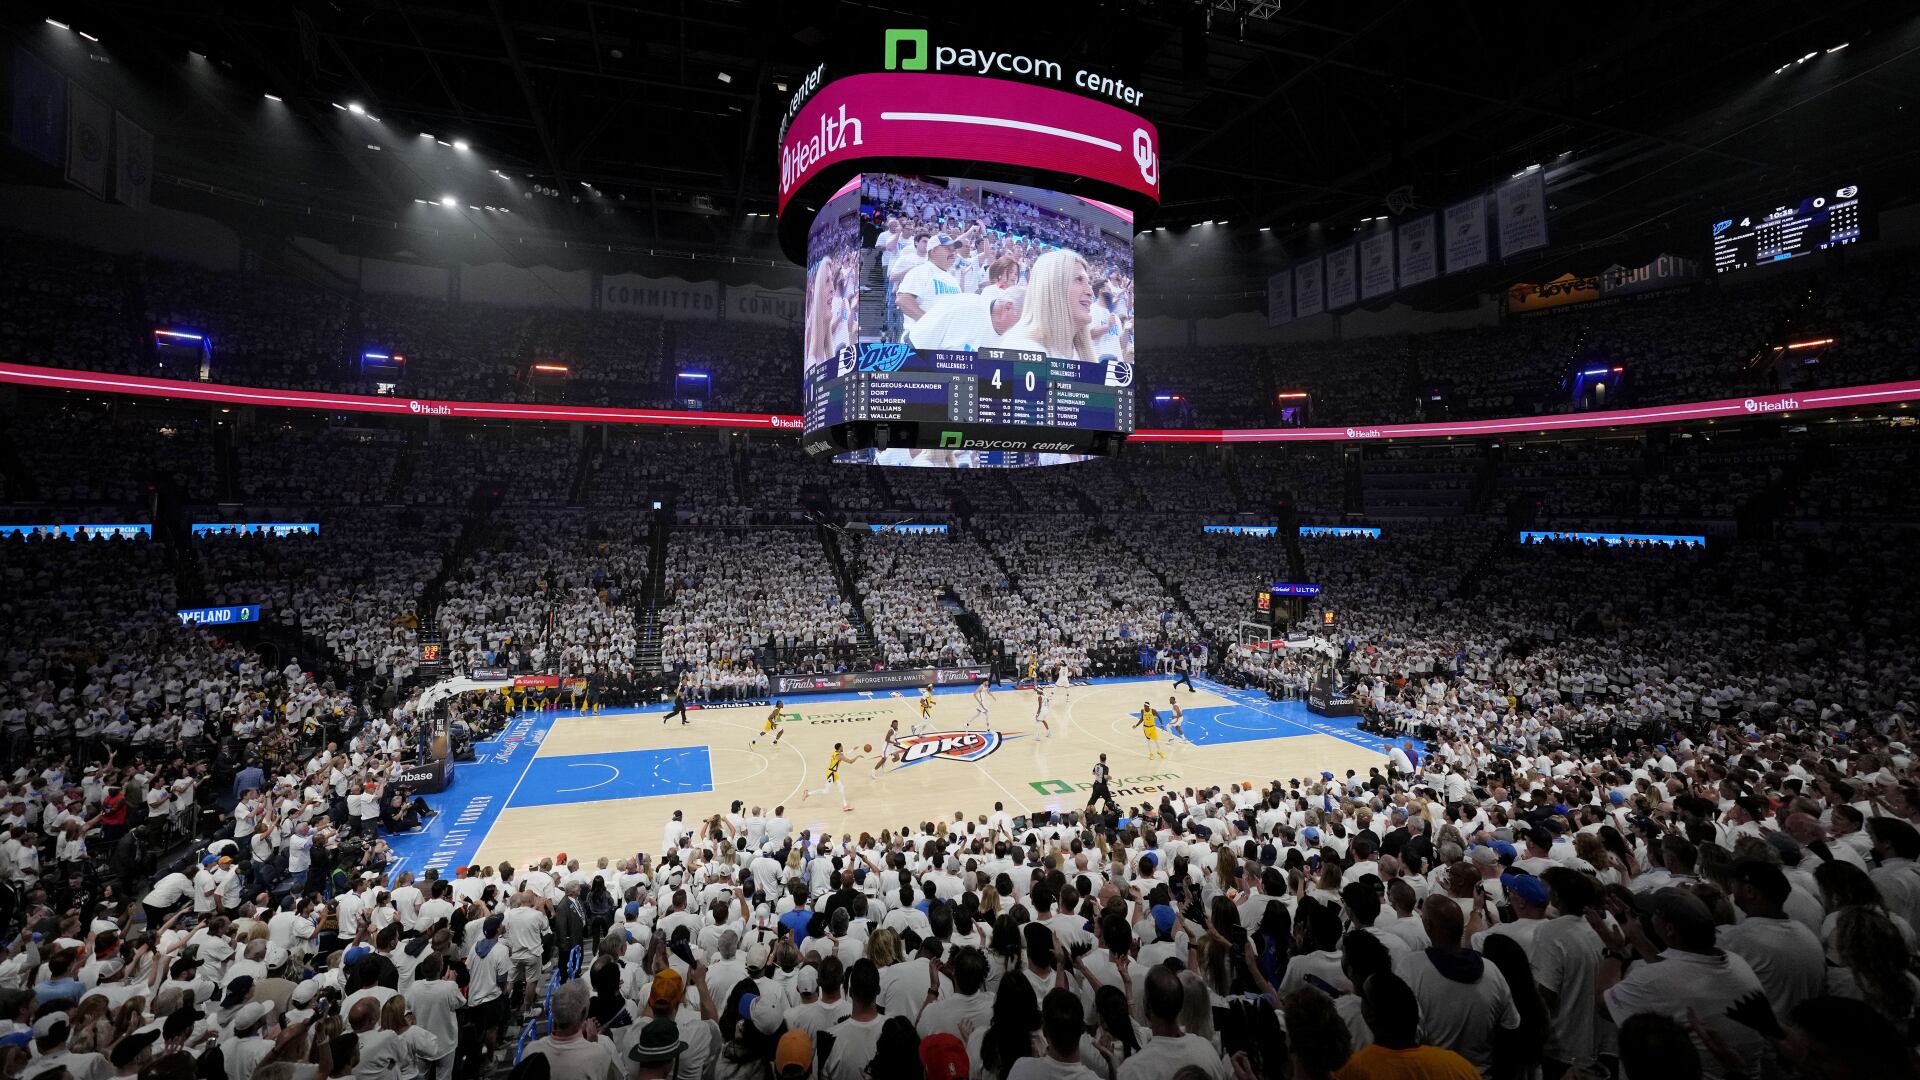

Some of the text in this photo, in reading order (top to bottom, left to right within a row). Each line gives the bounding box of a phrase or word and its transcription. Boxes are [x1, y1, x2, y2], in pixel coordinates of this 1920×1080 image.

[936, 46, 1144, 106] paycom center
[789, 62, 824, 117] center
[791, 104, 863, 184] Health
[1813, 197, 1825, 208] 0
[1740, 217, 1750, 227] 4
[607, 286, 714, 311] COMMITTED
[739, 297, 798, 317] COMMU
[989, 351, 1043, 362] 1ST 10:38
[991, 368, 1002, 390] 4
[1025, 371, 1036, 392] 0
[870, 382, 942, 390] GILGEOUS-ALEXANDER
[1057, 391, 1090, 399] HALIBURTON
[421, 404, 451, 415] Health
[1759, 398, 1798, 412] Health
[780, 419, 804, 428] Health
[1356, 430, 1380, 438] Health
[964, 438, 1075, 451] paycom center
[424, 652, 435, 660] 22
[853, 676, 902, 684] UNFORGETTABLE
[943, 670, 968, 682] Finals
[786, 677, 815, 692] Finals
[807, 708, 894, 725] paycom center
[400, 772, 433, 782] nbase
[1075, 773, 1181, 791] pycom
[1110, 784, 1166, 798] enter
[439, 829, 471, 847] CITY
